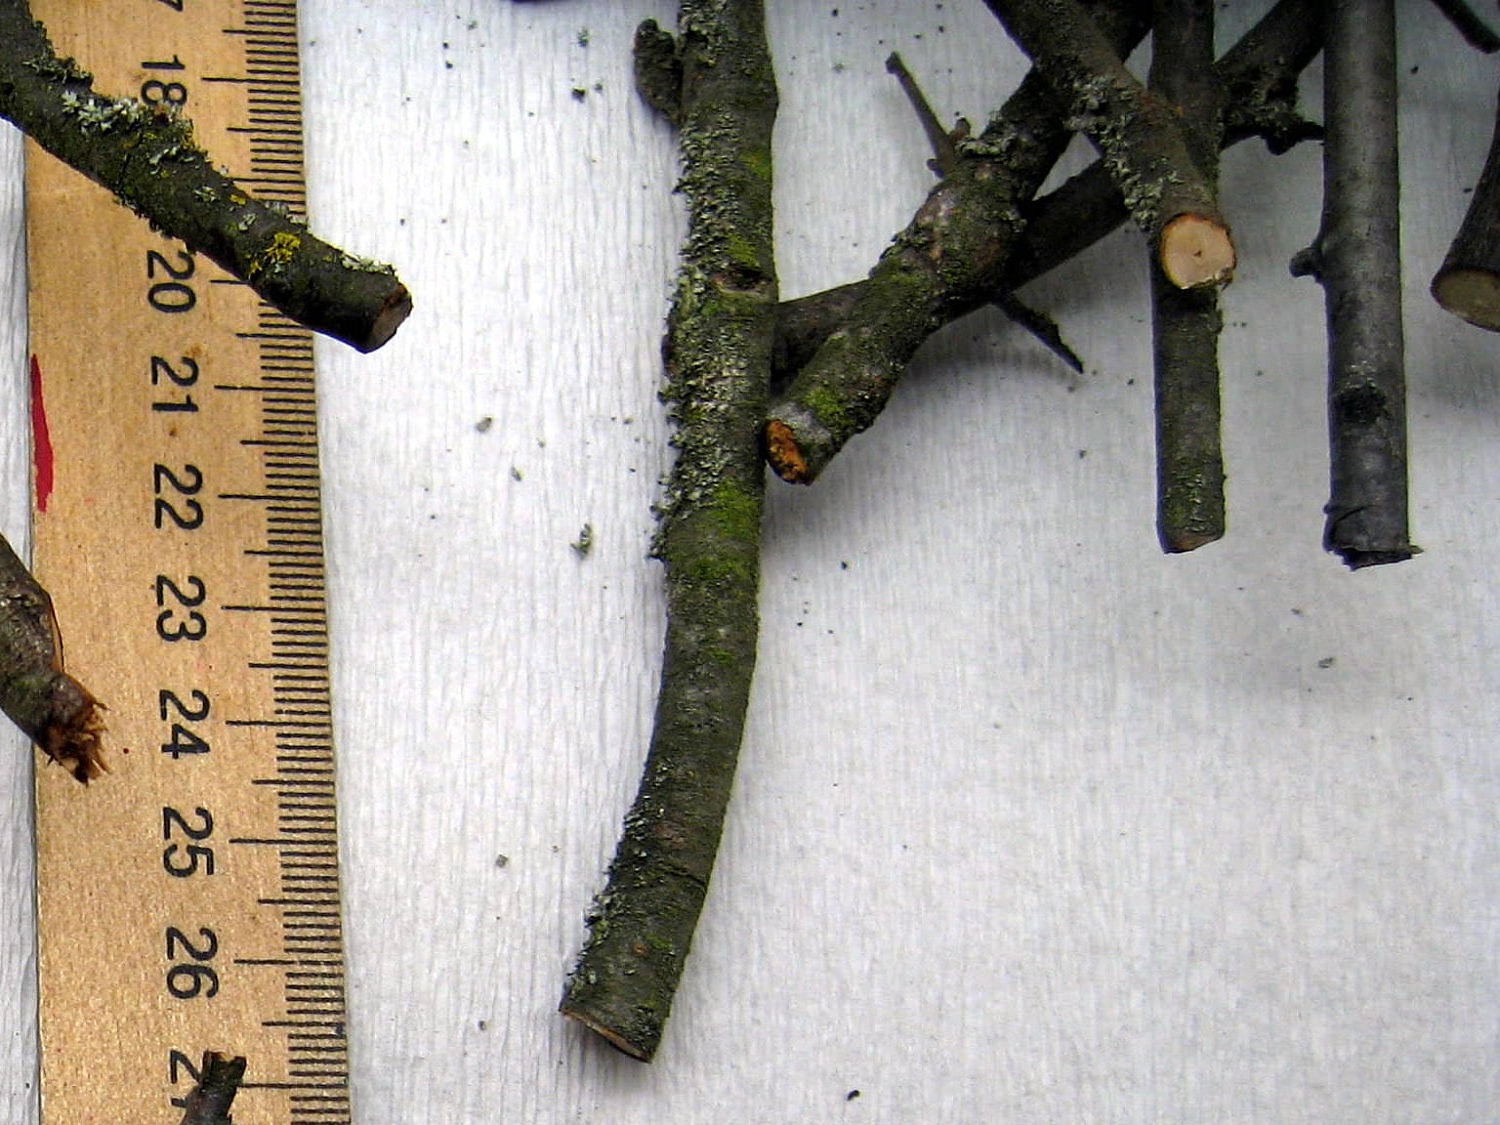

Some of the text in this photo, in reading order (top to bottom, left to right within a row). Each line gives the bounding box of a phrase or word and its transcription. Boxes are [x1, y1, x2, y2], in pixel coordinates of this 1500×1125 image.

[140, 54, 188, 106] 18
[147, 250, 197, 314] 20
[150, 356, 200, 413] 21
[153, 463, 204, 531] 22
[155, 575, 207, 643] 23
[158, 689, 211, 760] 24
[162, 806, 215, 879] 25
[166, 926, 220, 1000] 26
